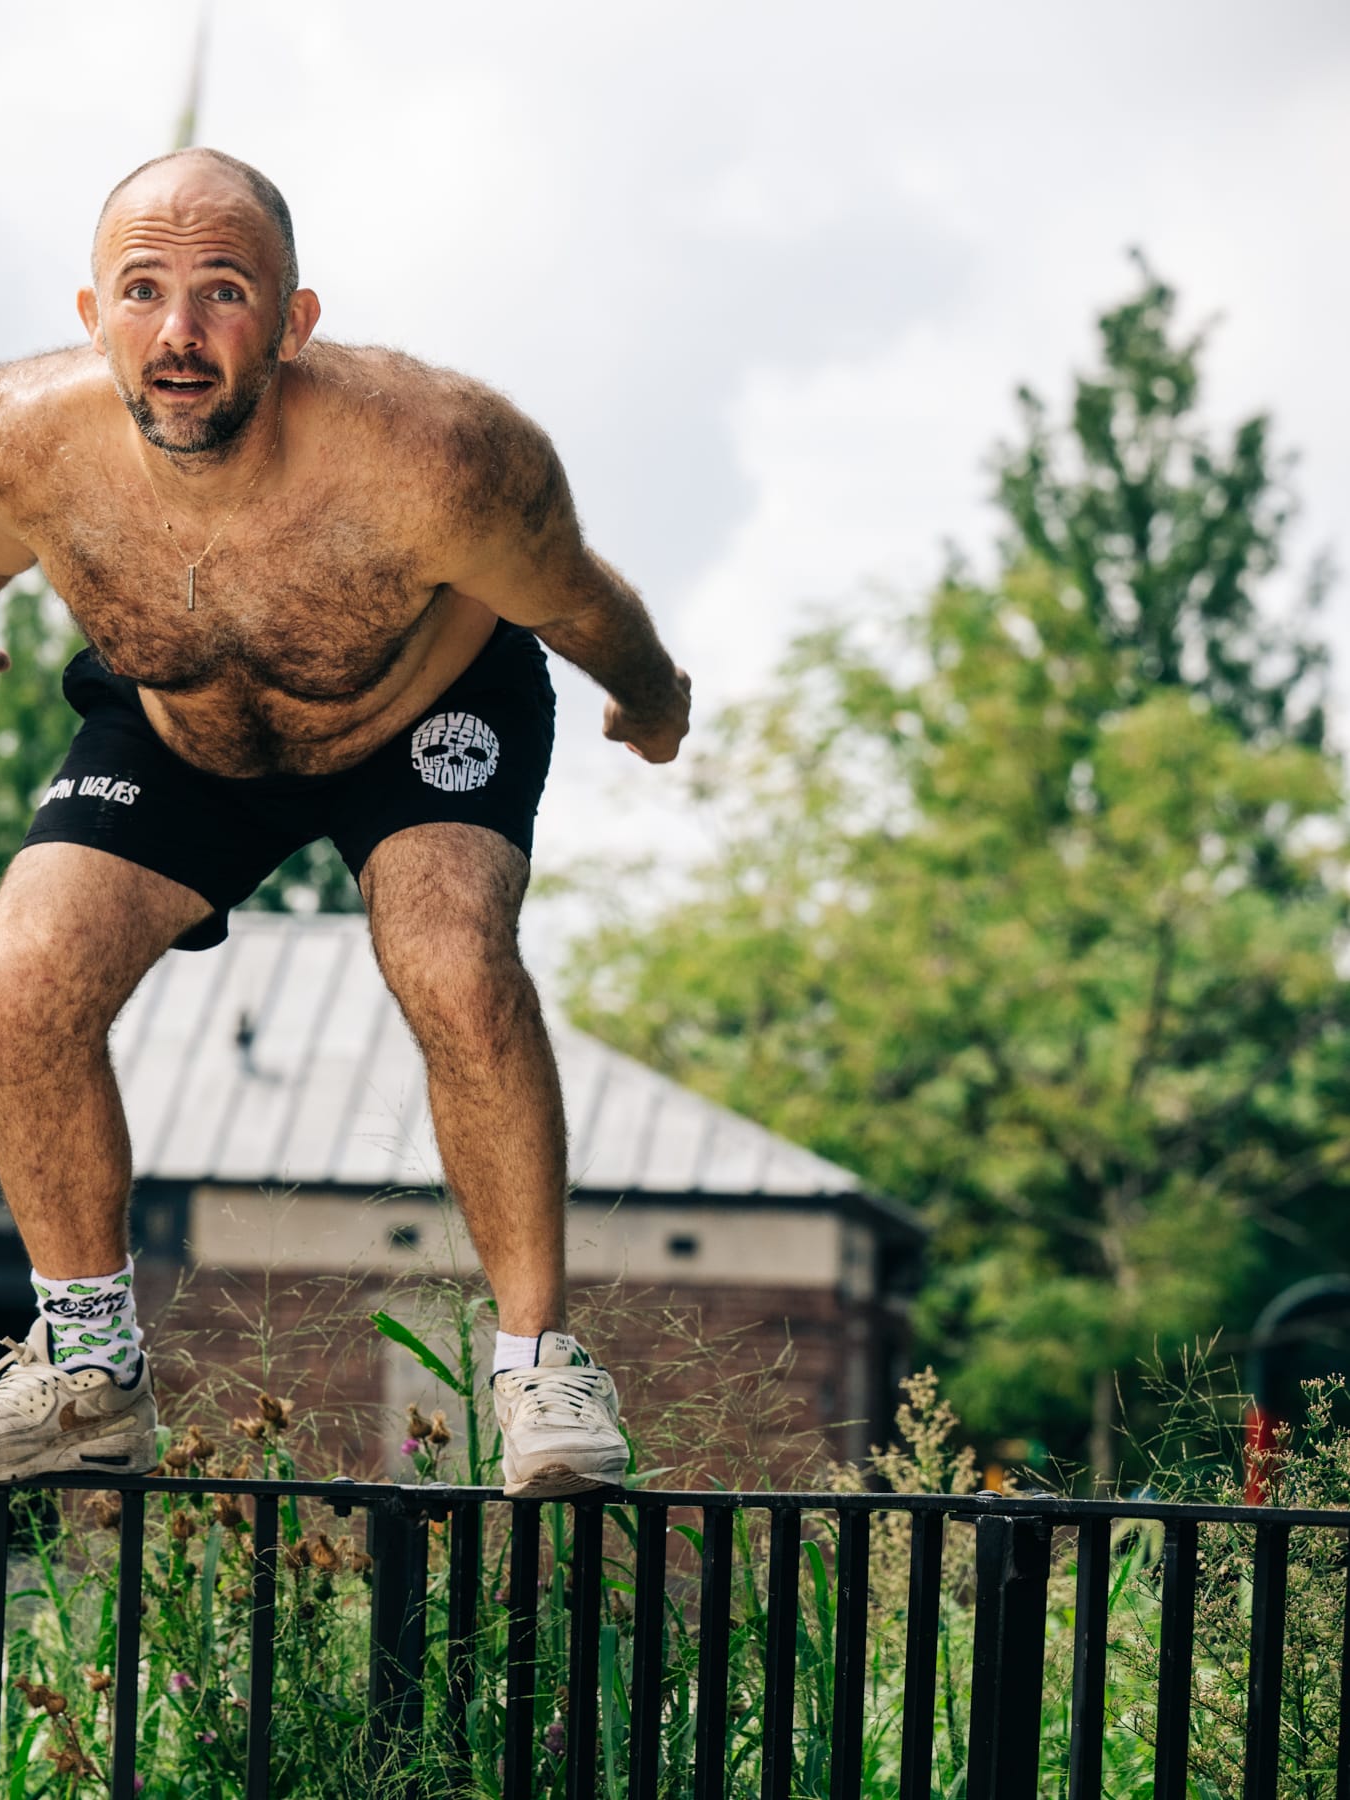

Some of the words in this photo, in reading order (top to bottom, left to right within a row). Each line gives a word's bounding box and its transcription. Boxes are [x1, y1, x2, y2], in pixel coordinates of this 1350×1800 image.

[411, 752, 450, 770] JUST
[462, 755, 496, 776] DYING
[421, 764, 488, 791] SLOWER
